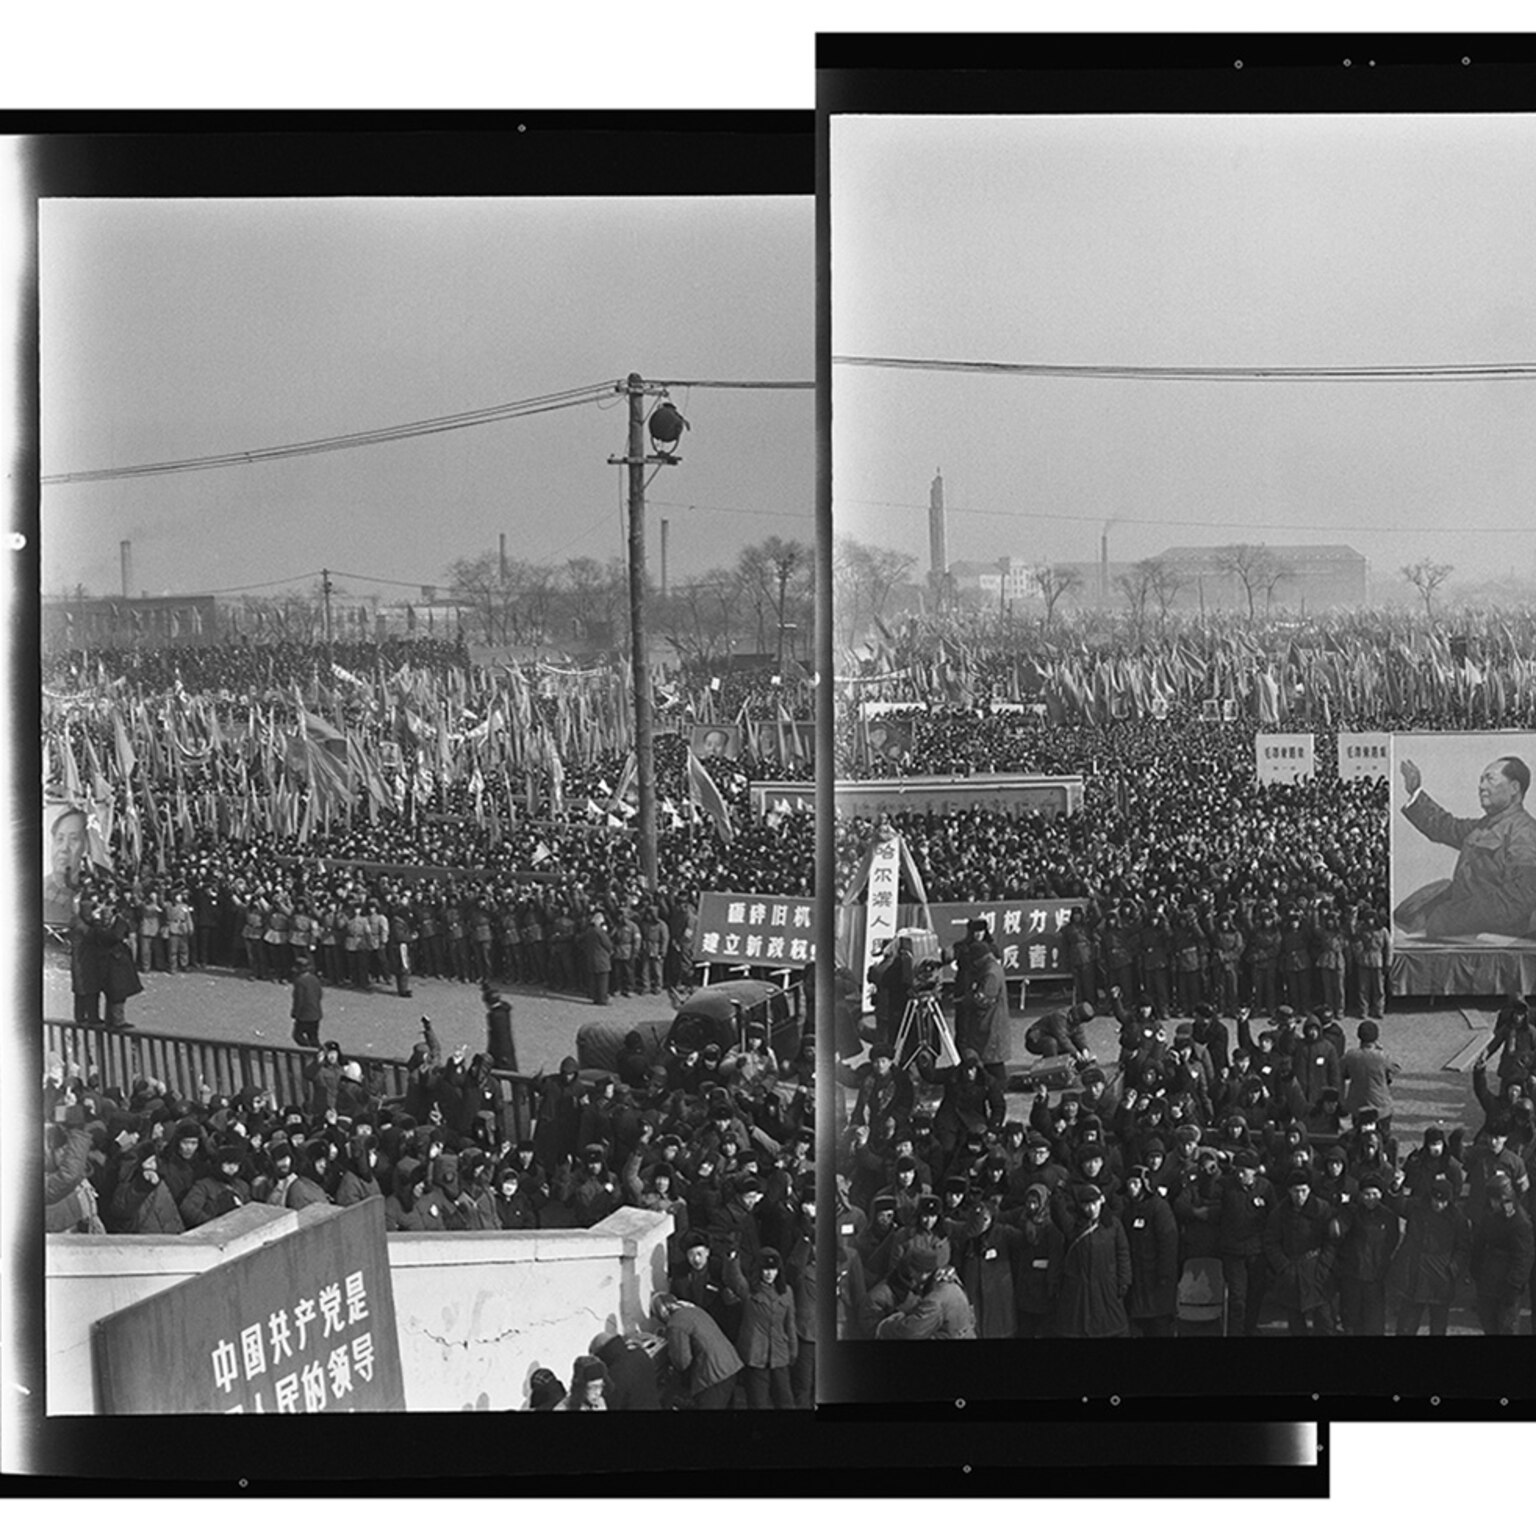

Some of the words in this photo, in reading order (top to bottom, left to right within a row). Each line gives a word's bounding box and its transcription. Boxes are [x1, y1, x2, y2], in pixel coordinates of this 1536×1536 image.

[211, 1270, 369, 1393] 中国共产党是
[225, 1332, 374, 1413] 民的领导
